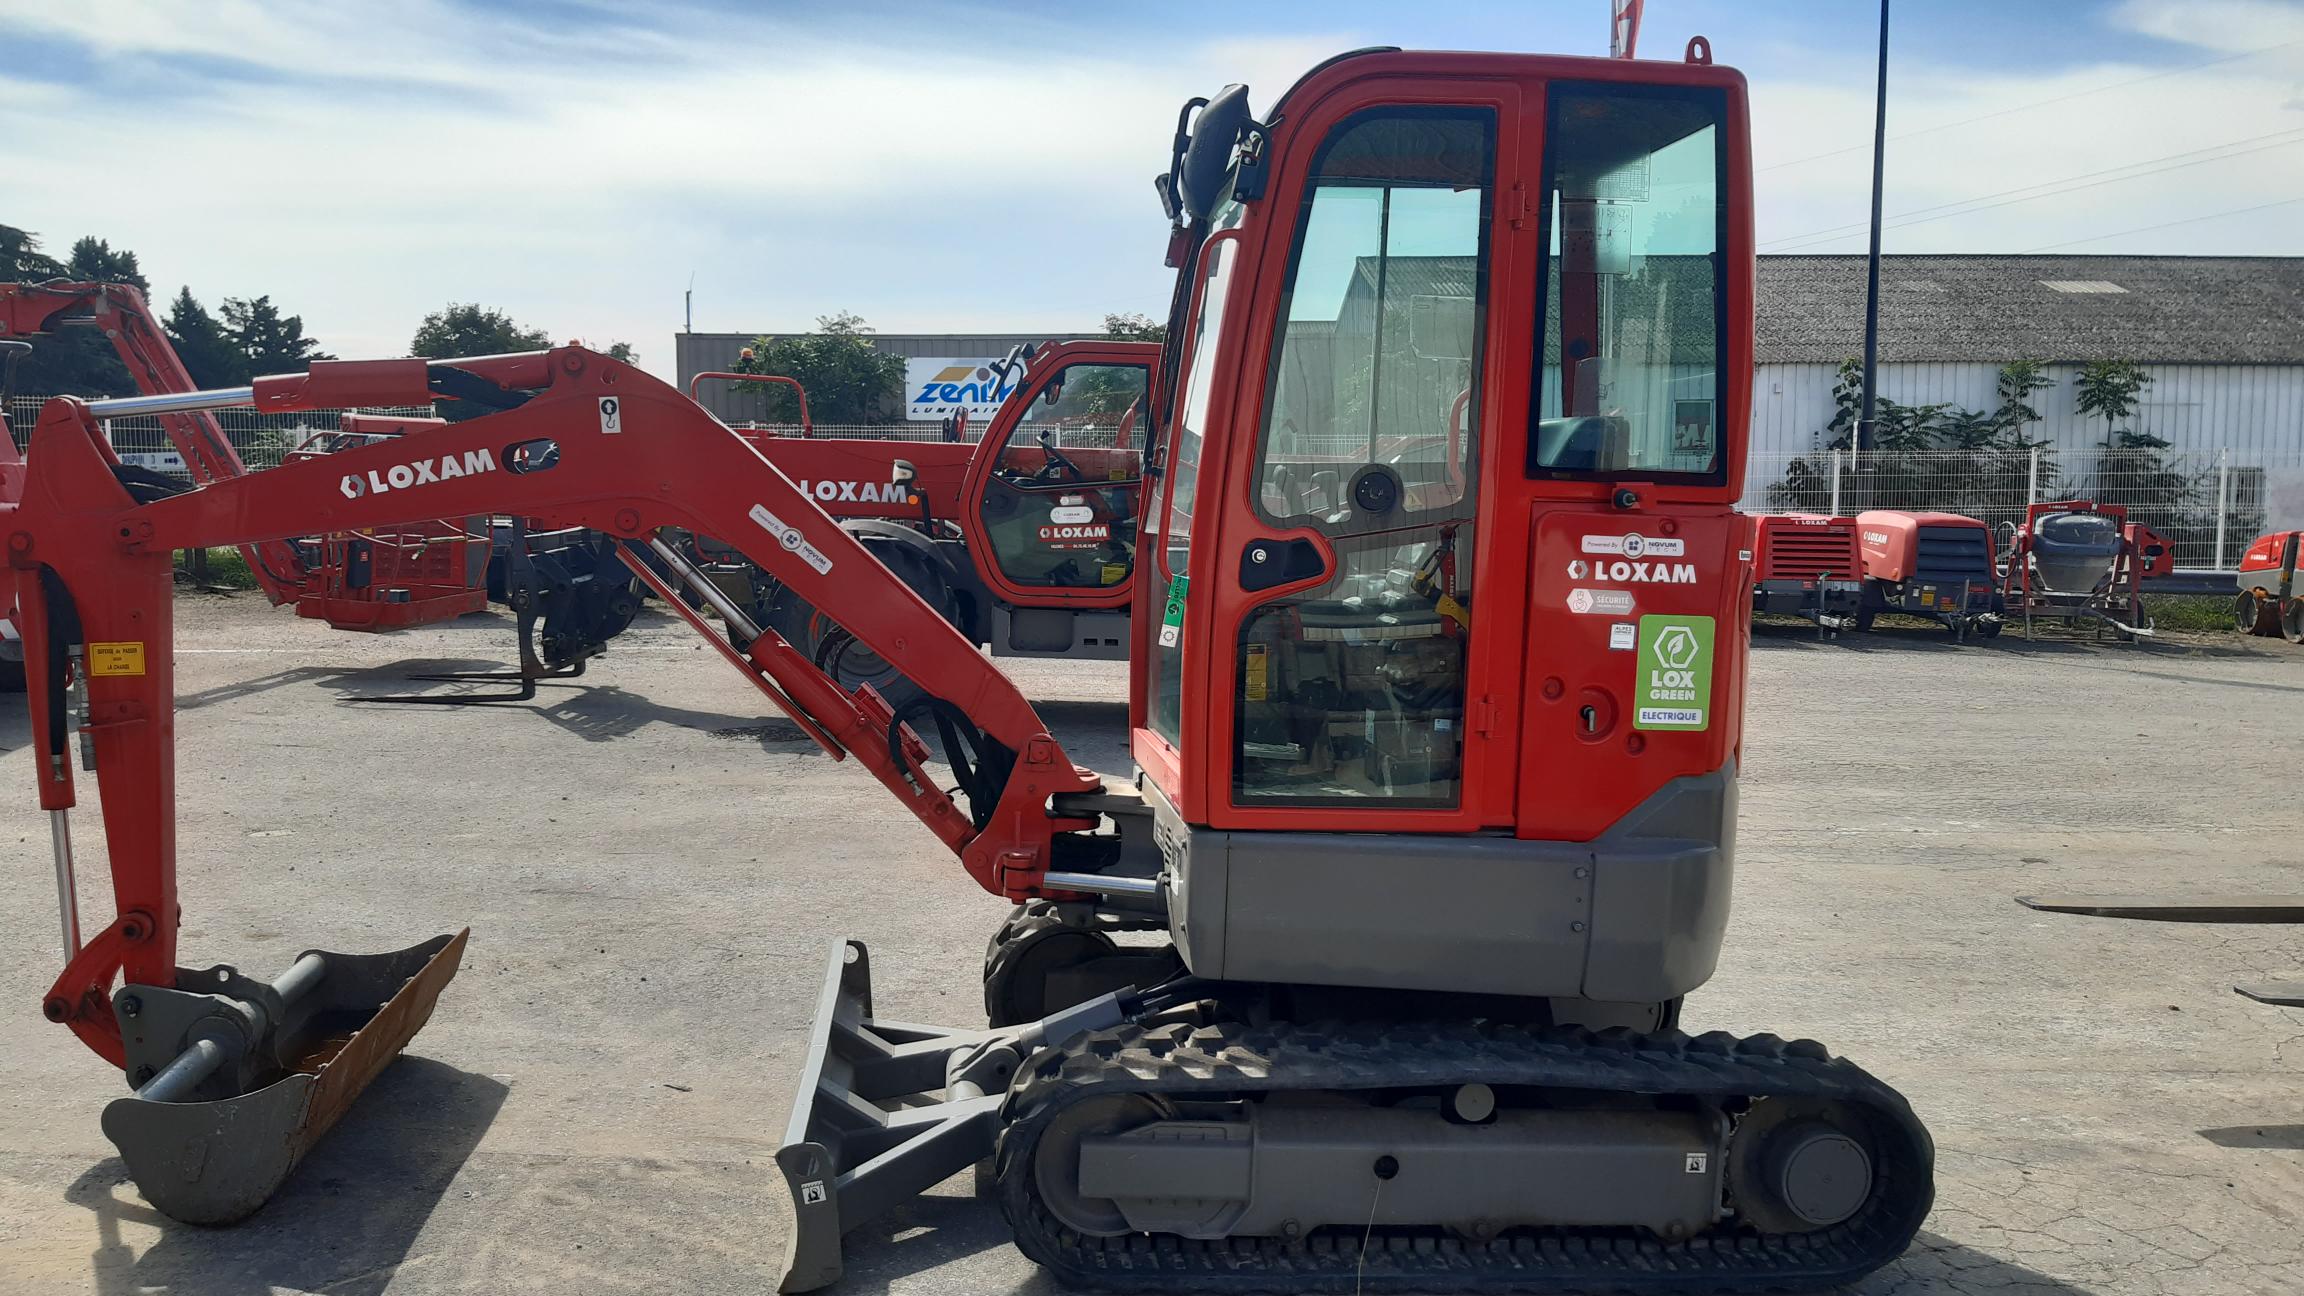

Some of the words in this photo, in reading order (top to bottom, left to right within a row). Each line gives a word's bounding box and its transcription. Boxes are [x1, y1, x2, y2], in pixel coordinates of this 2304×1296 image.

[367, 448, 497, 495] LOXAM
[800, 479, 907, 504] LOXAM
[1053, 526, 1108, 539] LOXAM
[803, 545, 827, 566] NOVUM
[1594, 560, 1697, 584] LOXAM
[1596, 595, 1630, 605] SÉCURITÉ
[1651, 669, 1695, 688] LOX
[1649, 689, 1696, 701] GREEN
[1642, 711, 1697, 721] ELECTRIQUE
